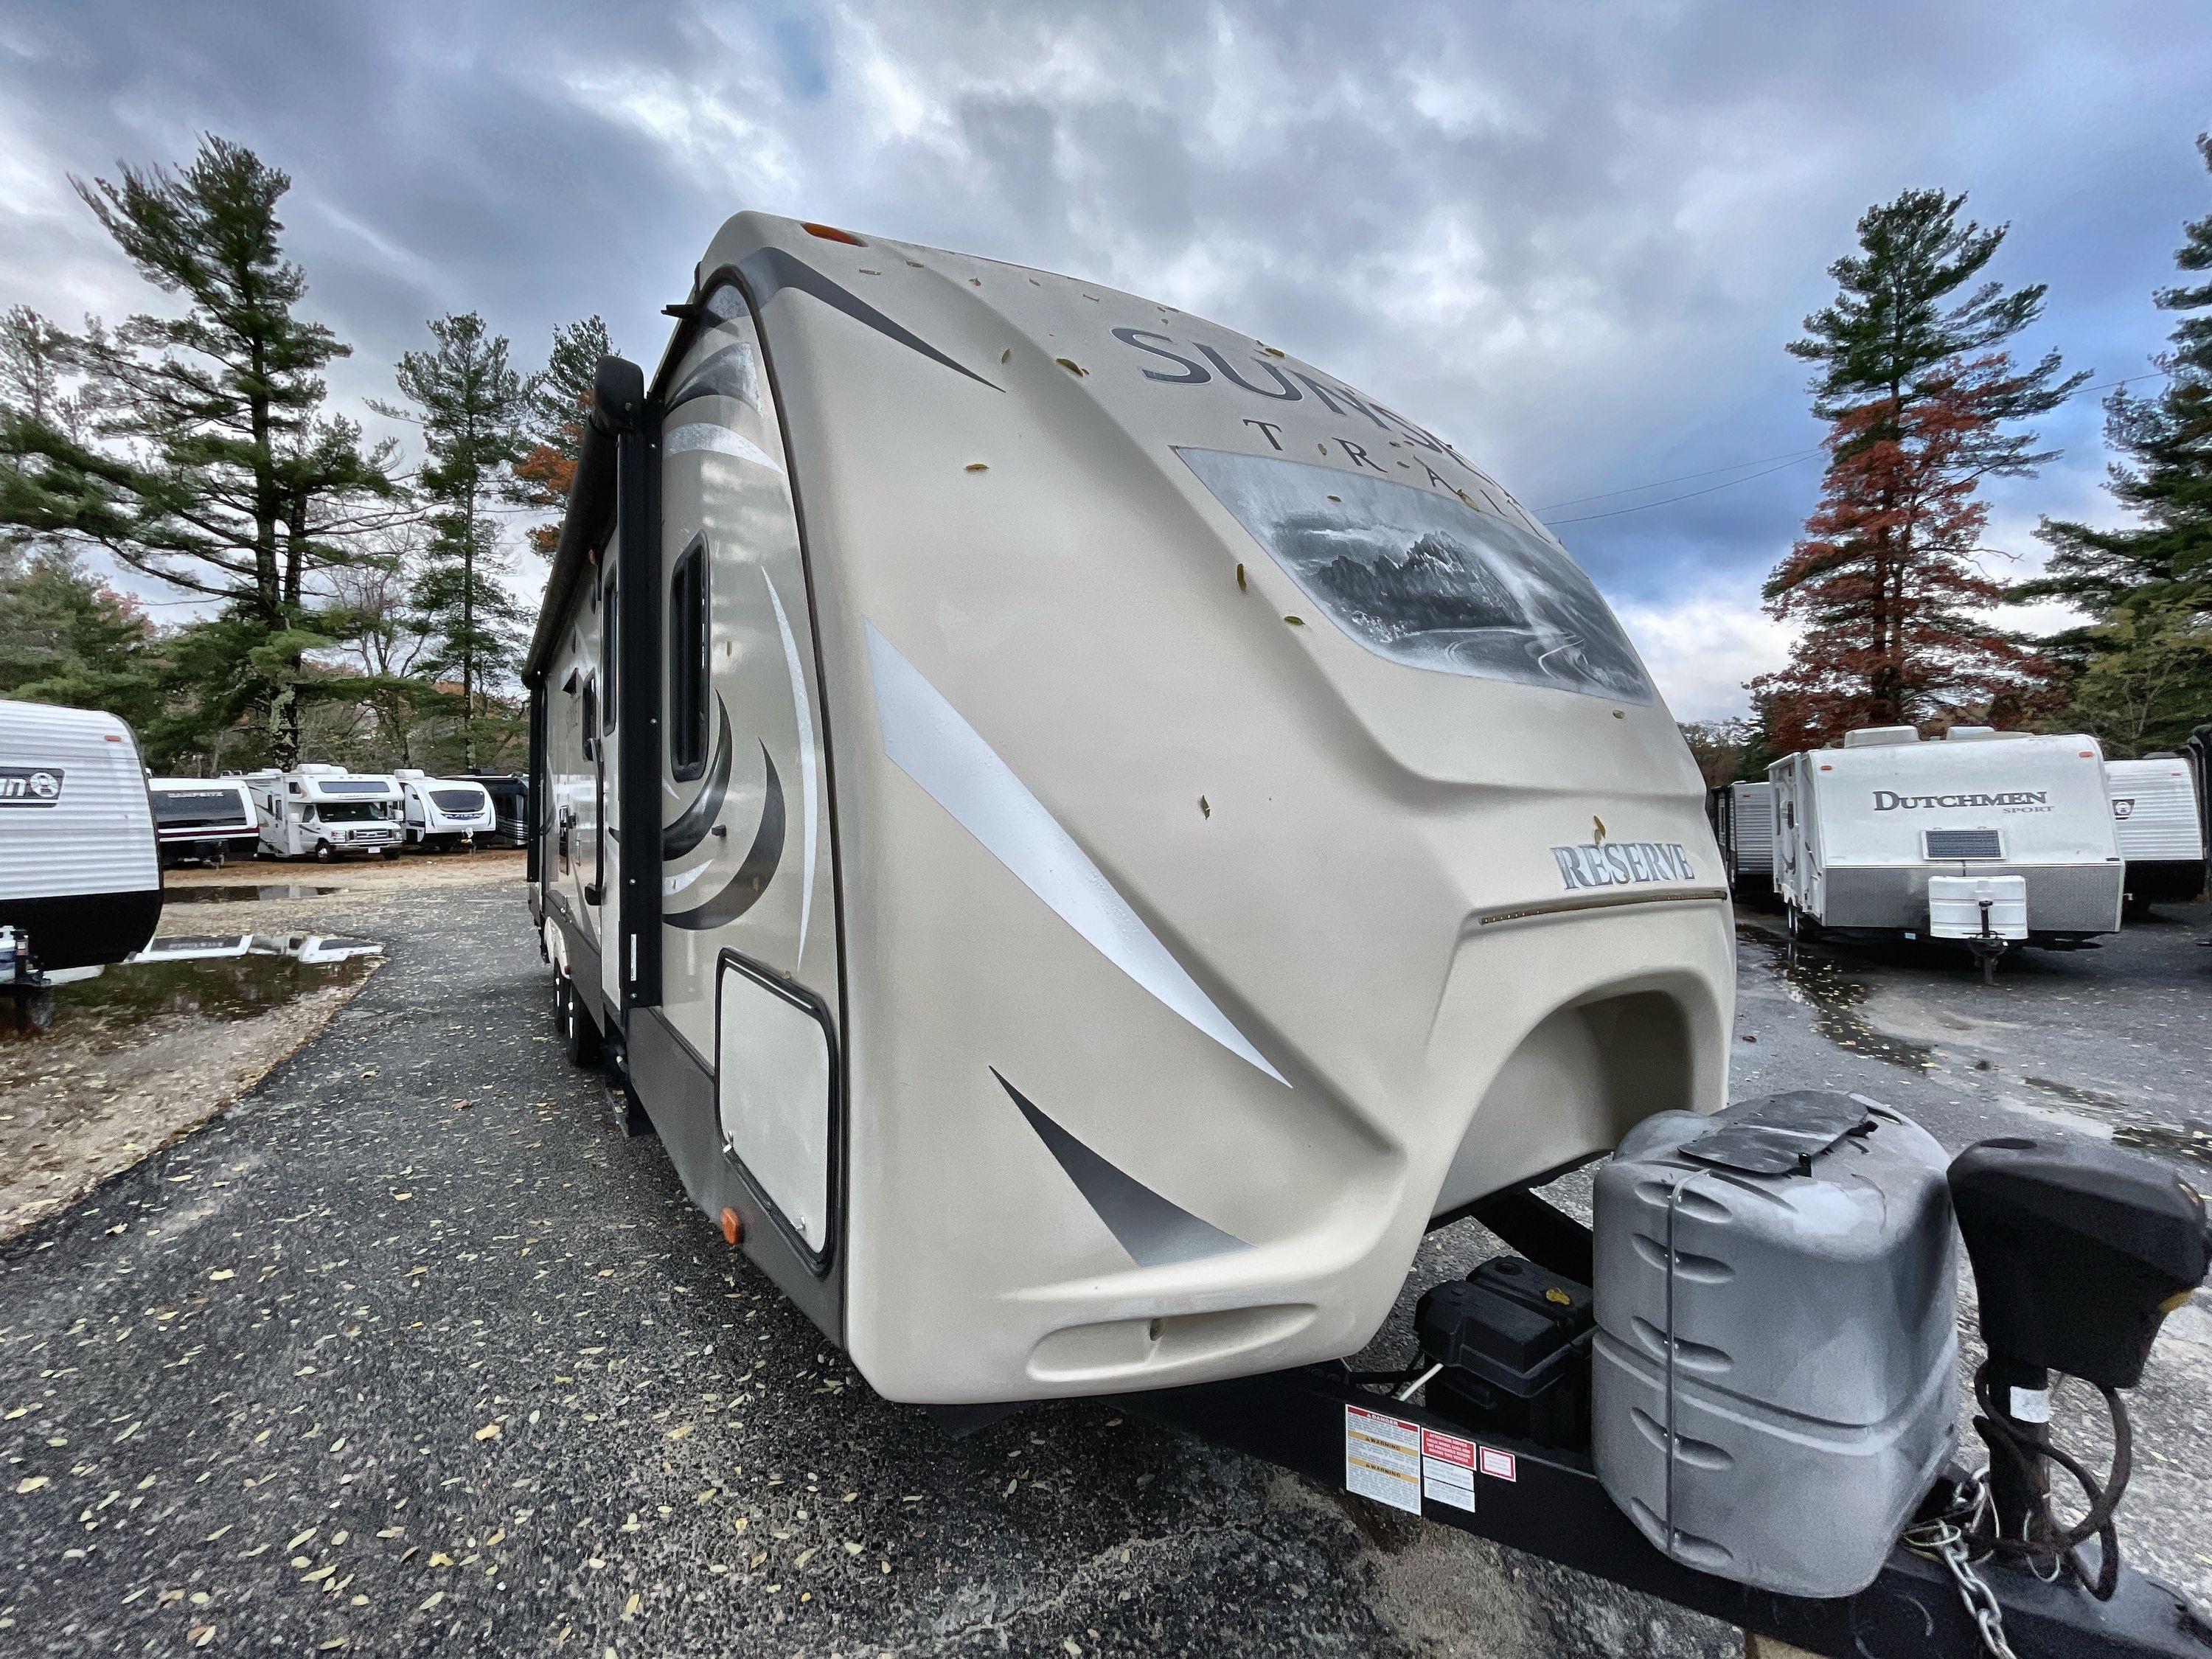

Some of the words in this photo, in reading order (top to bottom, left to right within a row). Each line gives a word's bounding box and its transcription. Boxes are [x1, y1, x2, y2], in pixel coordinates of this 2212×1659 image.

[1872, 790, 2048, 811] DUTCHMEN
[2003, 806, 2054, 815] SPORT
[1550, 843, 1695, 890] RESERVE
[1371, 1438, 1401, 1451] WARNING
[1371, 1464, 1401, 1478] WARNING
